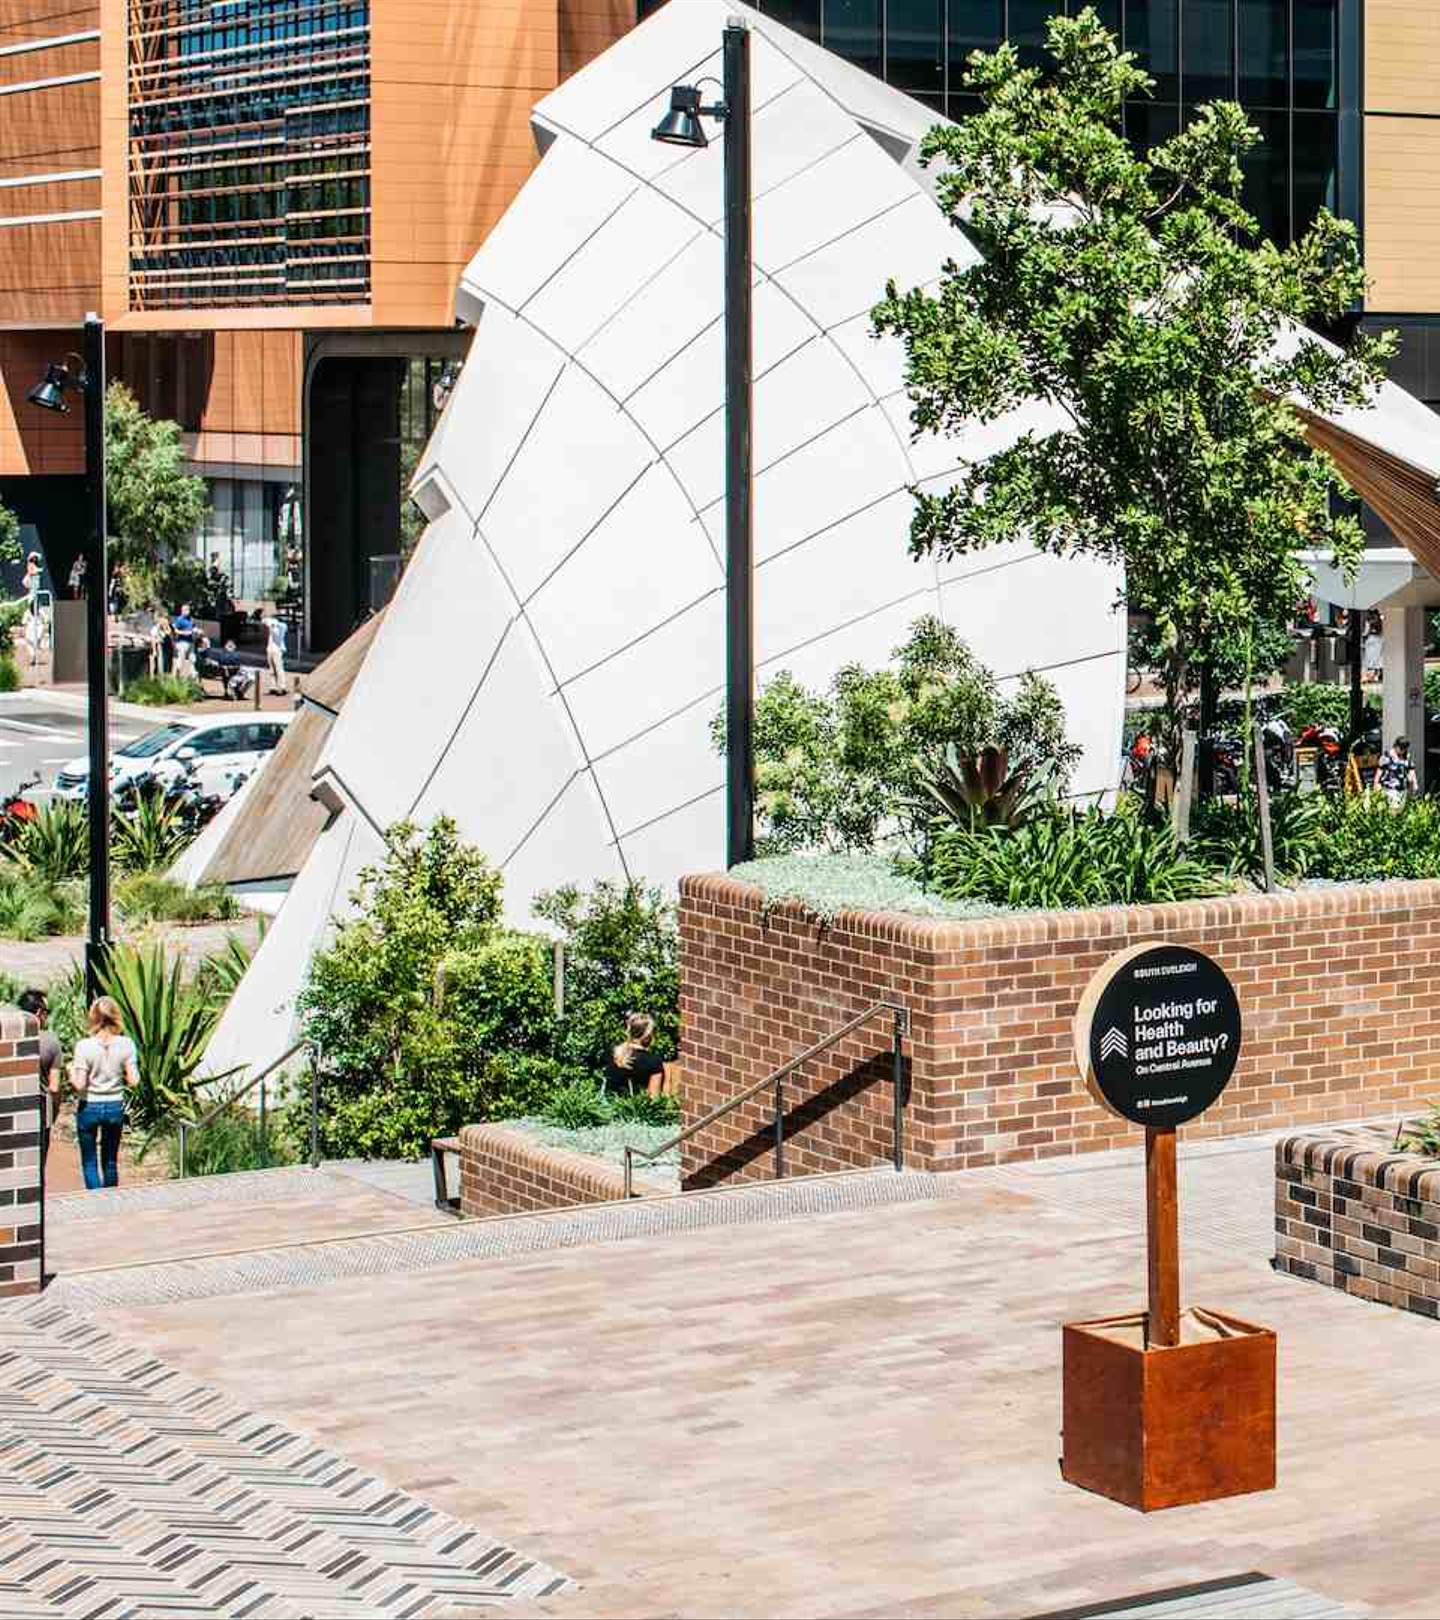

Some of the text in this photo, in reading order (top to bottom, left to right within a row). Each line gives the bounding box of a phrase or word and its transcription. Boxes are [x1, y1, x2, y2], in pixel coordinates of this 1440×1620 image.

[1134, 998, 1218, 1022] Looking for
[1135, 1020, 1184, 1042] Health
[1135, 1033, 1229, 1061] and Beauty?
[1135, 1065, 1149, 1075] On
